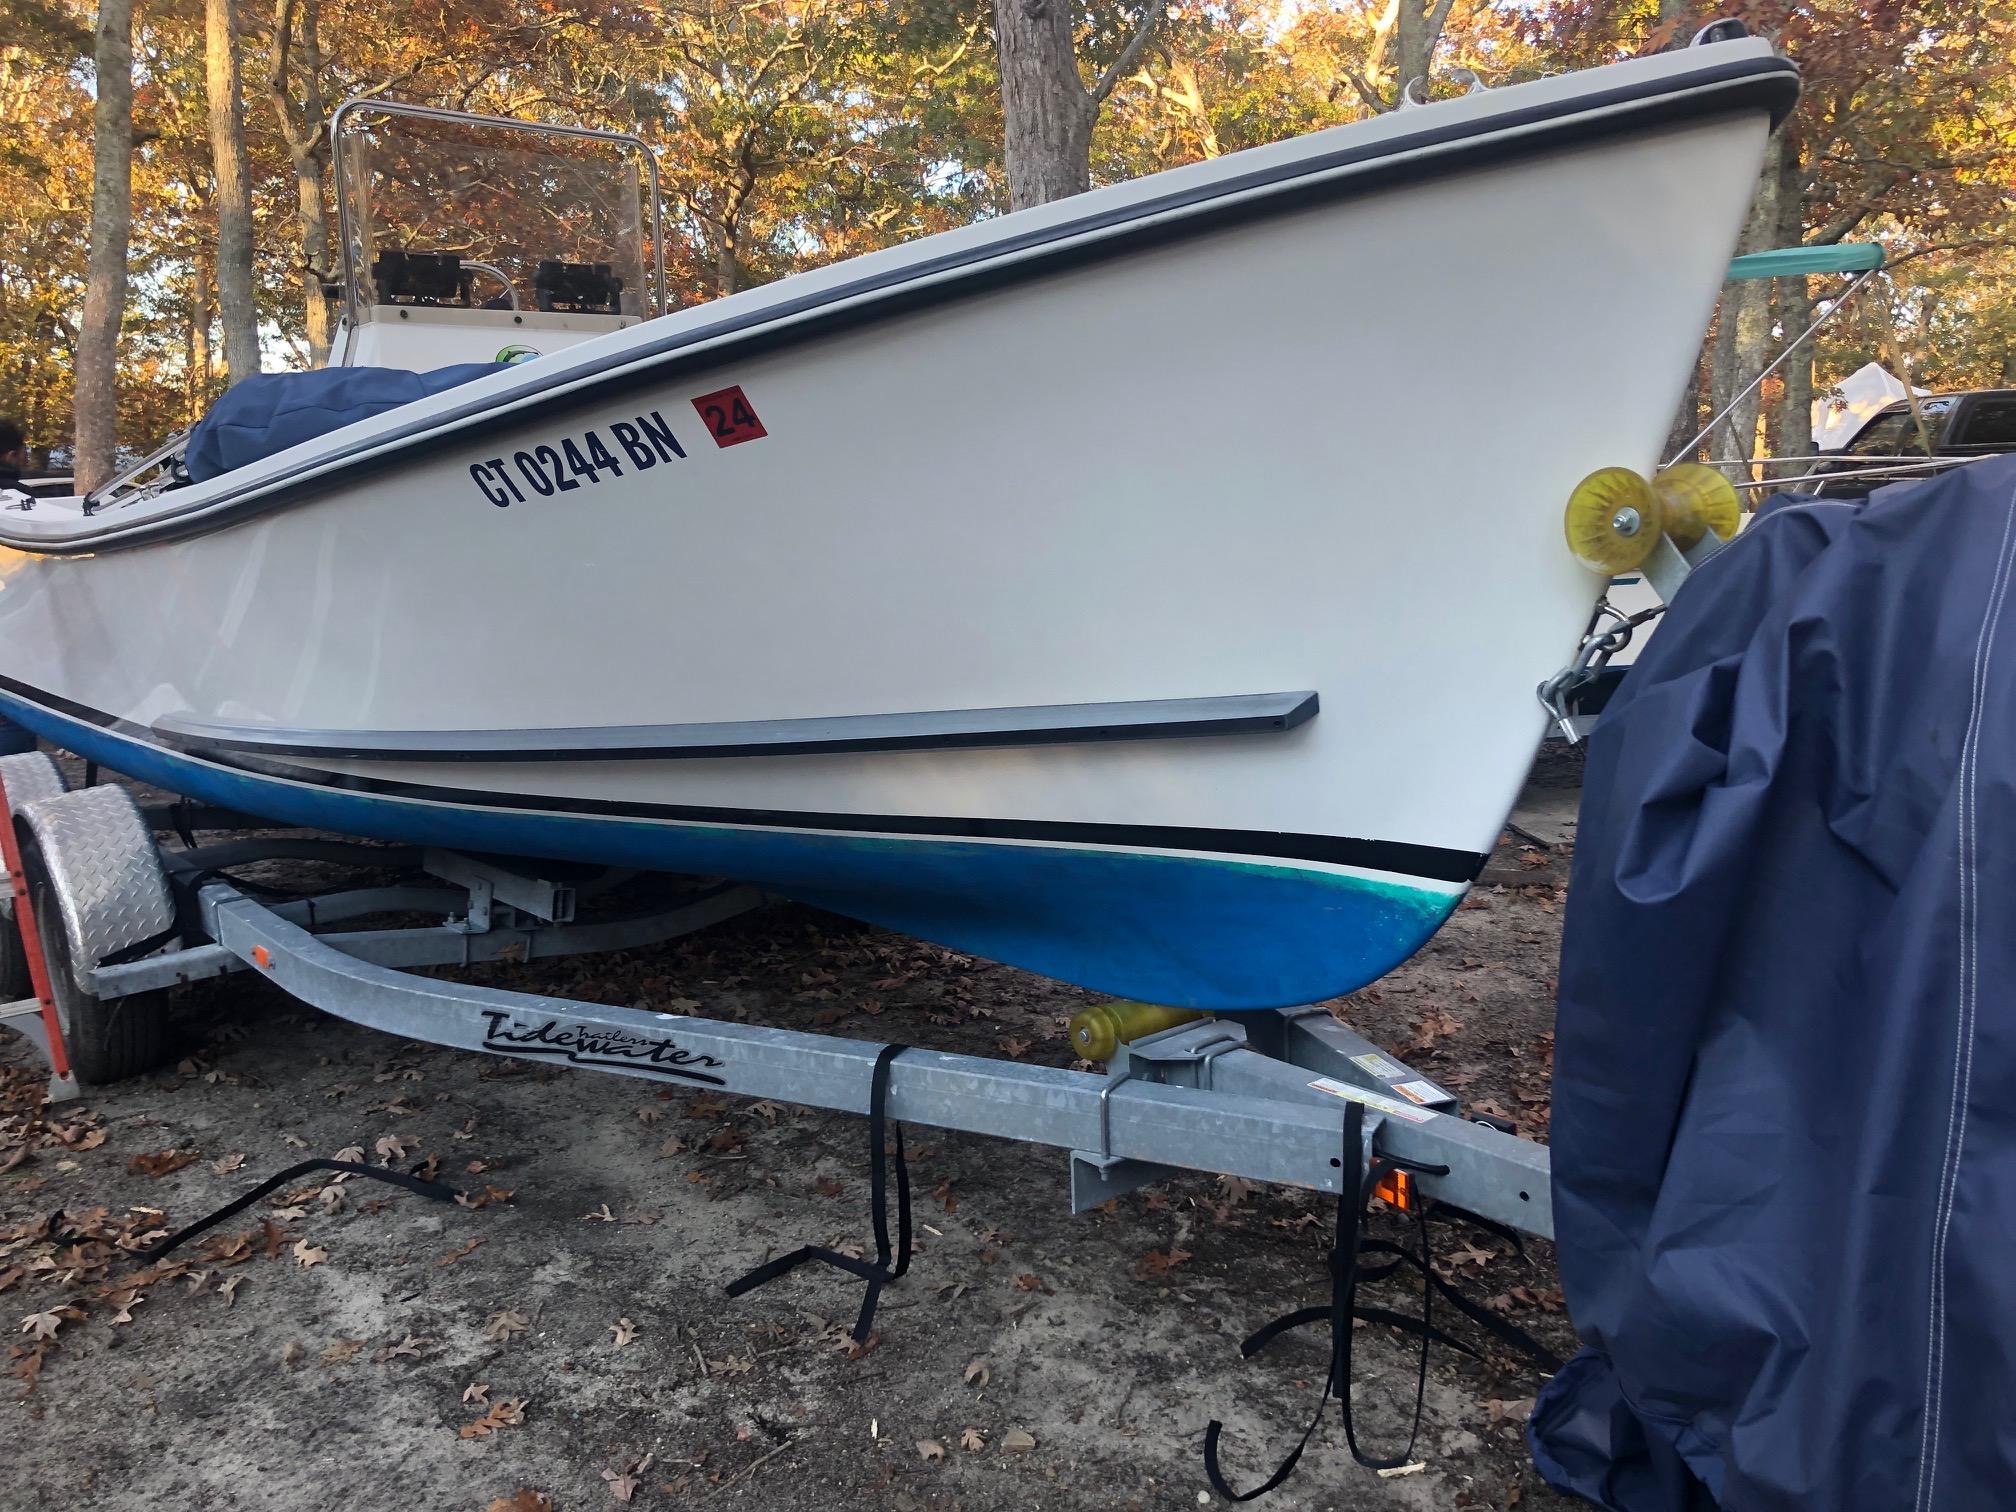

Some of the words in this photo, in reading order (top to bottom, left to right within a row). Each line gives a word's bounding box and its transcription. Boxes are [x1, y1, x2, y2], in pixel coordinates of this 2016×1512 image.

[705, 397, 756, 436] 24
[469, 458, 527, 508] CT
[513, 430, 624, 497] 0244
[609, 411, 688, 471] BN
